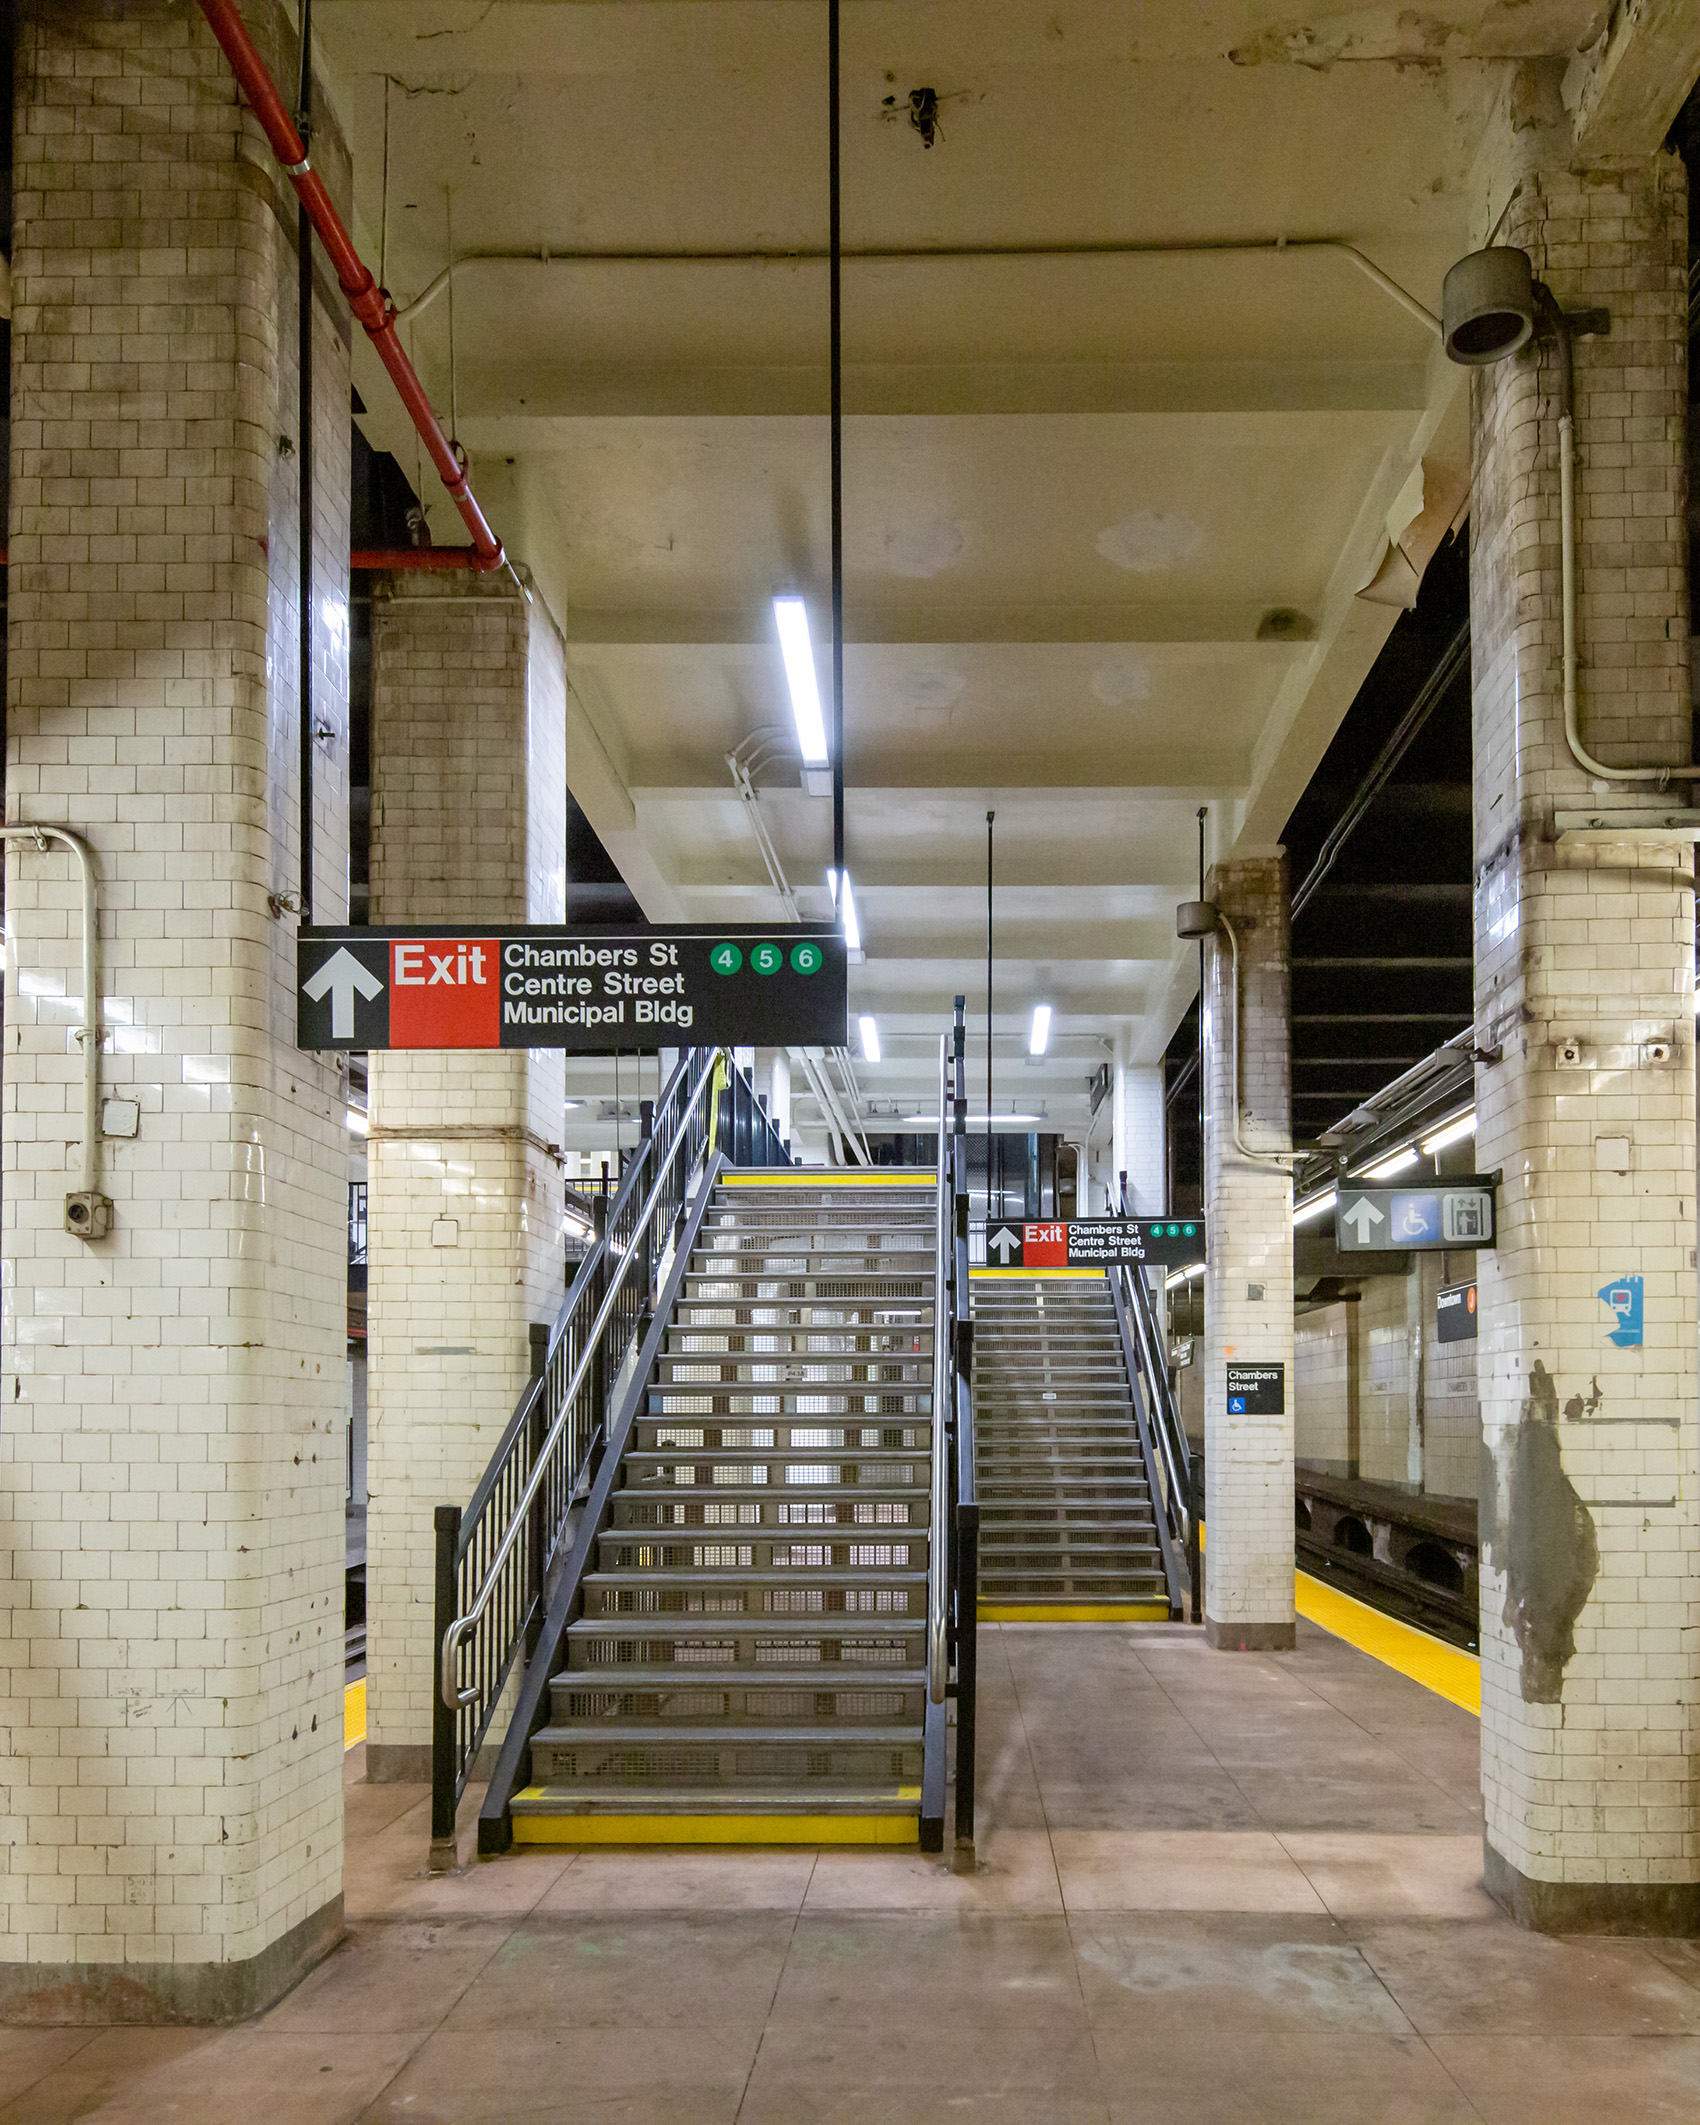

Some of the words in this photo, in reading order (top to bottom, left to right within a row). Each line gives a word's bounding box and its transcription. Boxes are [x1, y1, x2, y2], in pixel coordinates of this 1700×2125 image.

[504, 943, 638, 967] Chambers
[649, 942, 678, 966] St
[718, 949, 733, 968] 4
[759, 949, 773, 968] 5
[798, 949, 813, 968] 6
[395, 945, 487, 985] Exit
[504, 972, 592, 996] Centre
[603, 971, 685, 995] Street
[504, 1001, 624, 1026] Municipal
[635, 1000, 694, 1027] Bldg
[1025, 1225, 1062, 1242] Exit
[1068, 1224, 1122, 1235] Chambers
[1126, 1224, 1139, 1235] St
[1068, 1236, 1105, 1247] Centre
[1108, 1236, 1142, 1246] Street
[1068, 1248, 1118, 1259] Municipal
[1121, 1247, 1145, 1259] Bldg
[1228, 1371, 1278, 1380] Chambers
[1228, 1382, 1258, 1391] Street
